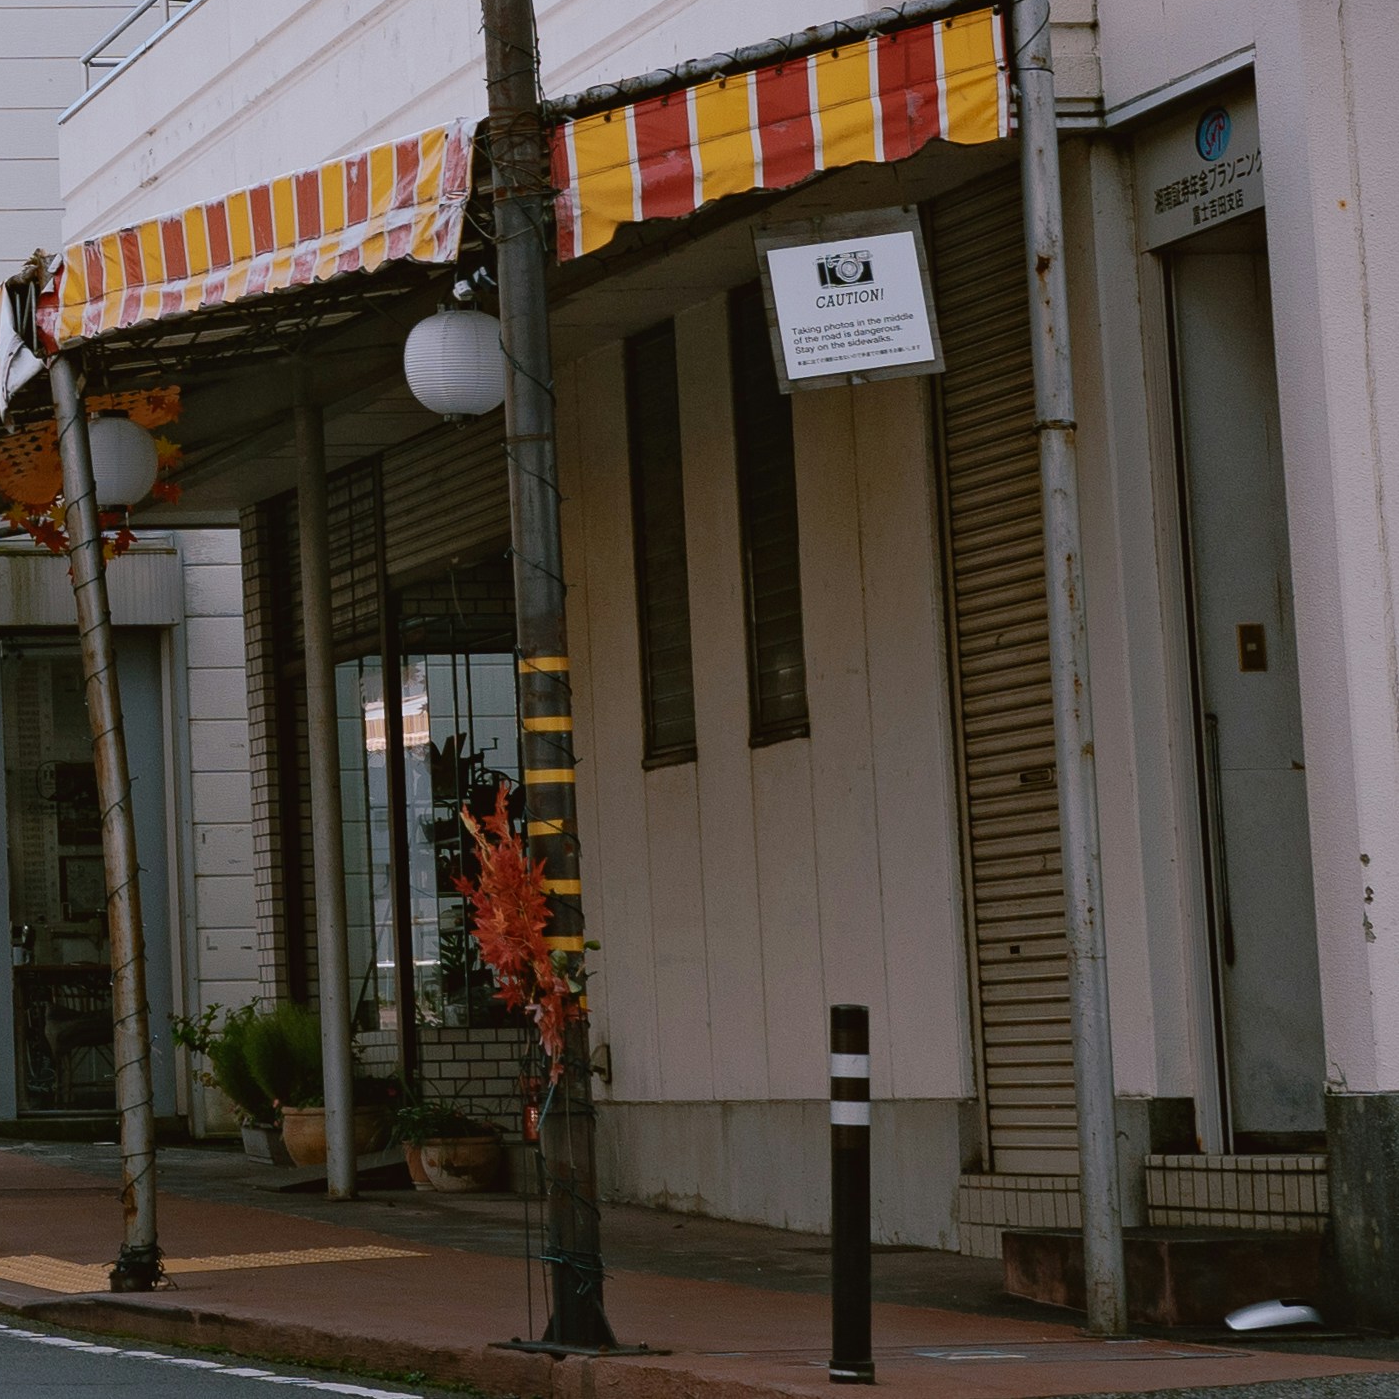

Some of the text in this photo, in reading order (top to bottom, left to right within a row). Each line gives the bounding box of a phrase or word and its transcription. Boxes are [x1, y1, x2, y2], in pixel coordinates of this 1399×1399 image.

[815, 287, 884, 309] CAUTION!
[791, 325, 822, 336] Taking
[824, 320, 854, 332] photos
[867, 317, 882, 325] the
[883, 313, 915, 323] middle
[793, 324, 903, 345] of the road is dangerous.
[795, 335, 894, 354] Stay on the sidewalks.
